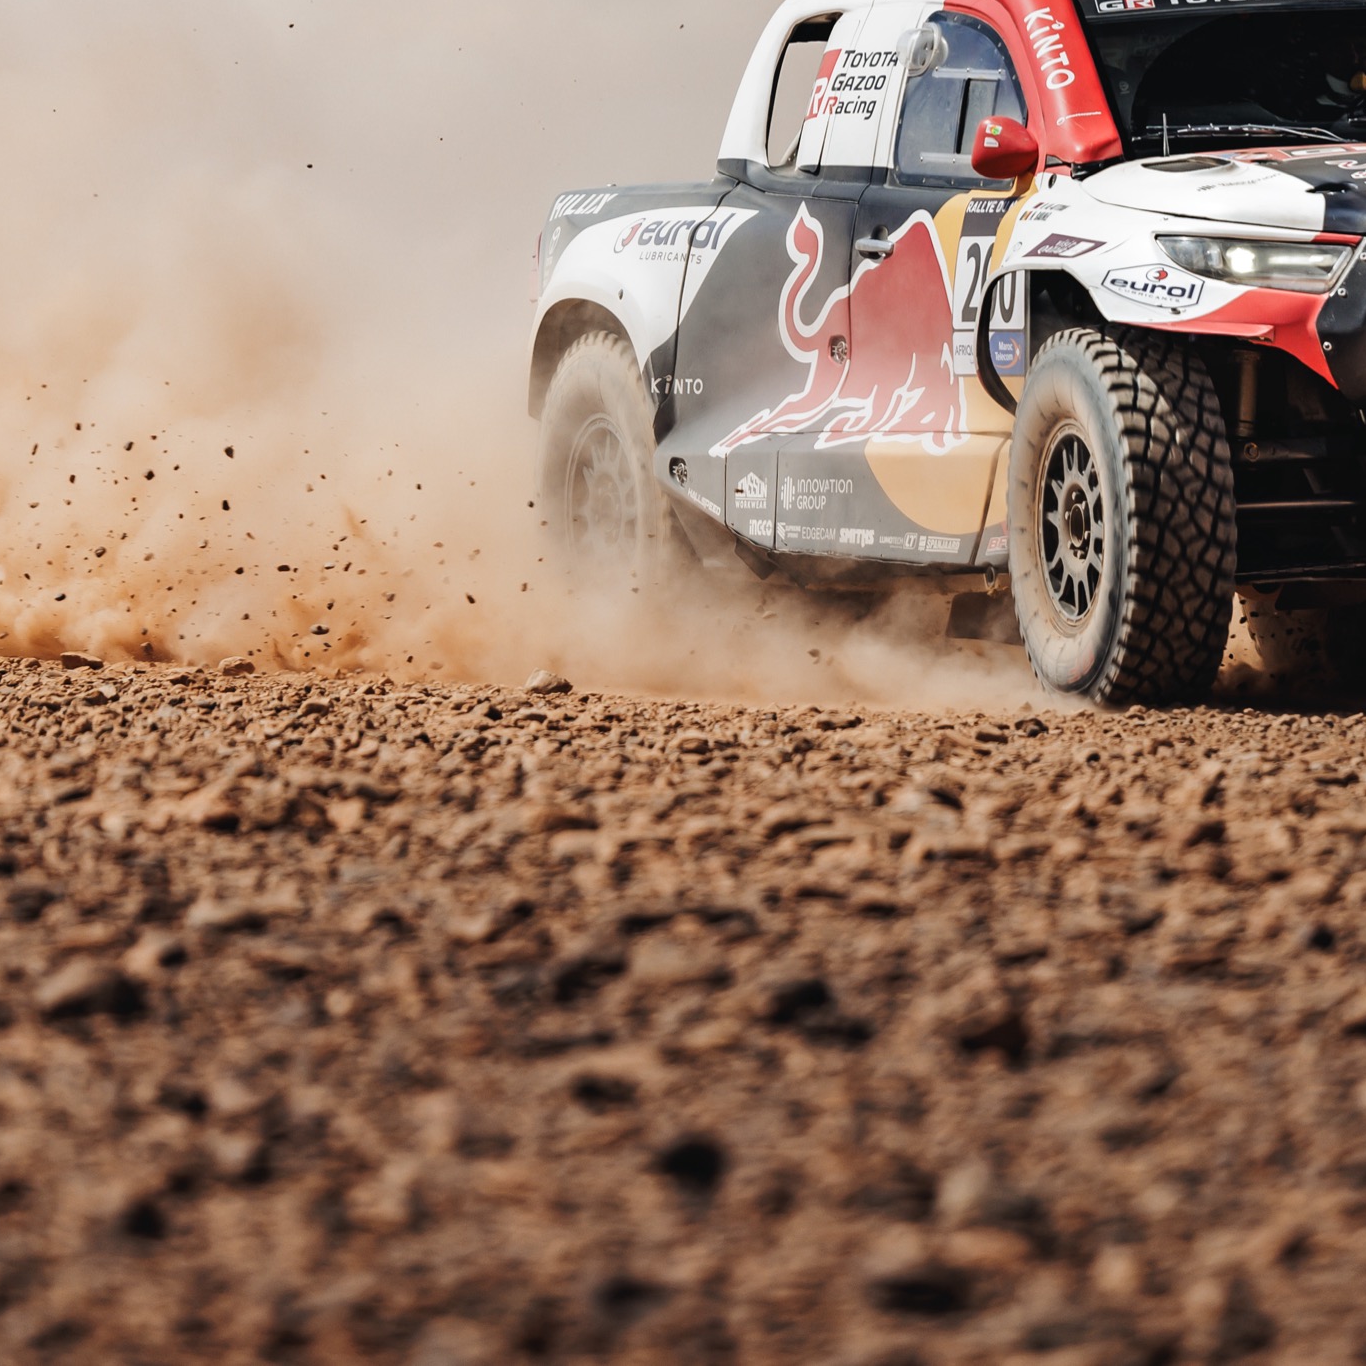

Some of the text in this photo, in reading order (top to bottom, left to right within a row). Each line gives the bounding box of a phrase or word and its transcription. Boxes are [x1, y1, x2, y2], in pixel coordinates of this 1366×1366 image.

[842, 50, 900, 68] TOYOTA
[831, 73, 886, 91] GAZOO
[823, 95, 877, 120] Racing
[549, 193, 618, 221] HILUX
[966, 201, 999, 213] RALLYE
[637, 213, 736, 250] eurol
[639, 251, 702, 264] LUBRICANTS
[1110, 278, 1196, 299] eurol
[998, 342, 1014, 351] Maroc
[995, 352, 1014, 362] Telecom
[797, 479, 853, 494] INNOVATION
[735, 500, 767, 510] WORKWEAR
[797, 495, 827, 510] GROUP
[802, 526, 836, 541] EDGECAM
